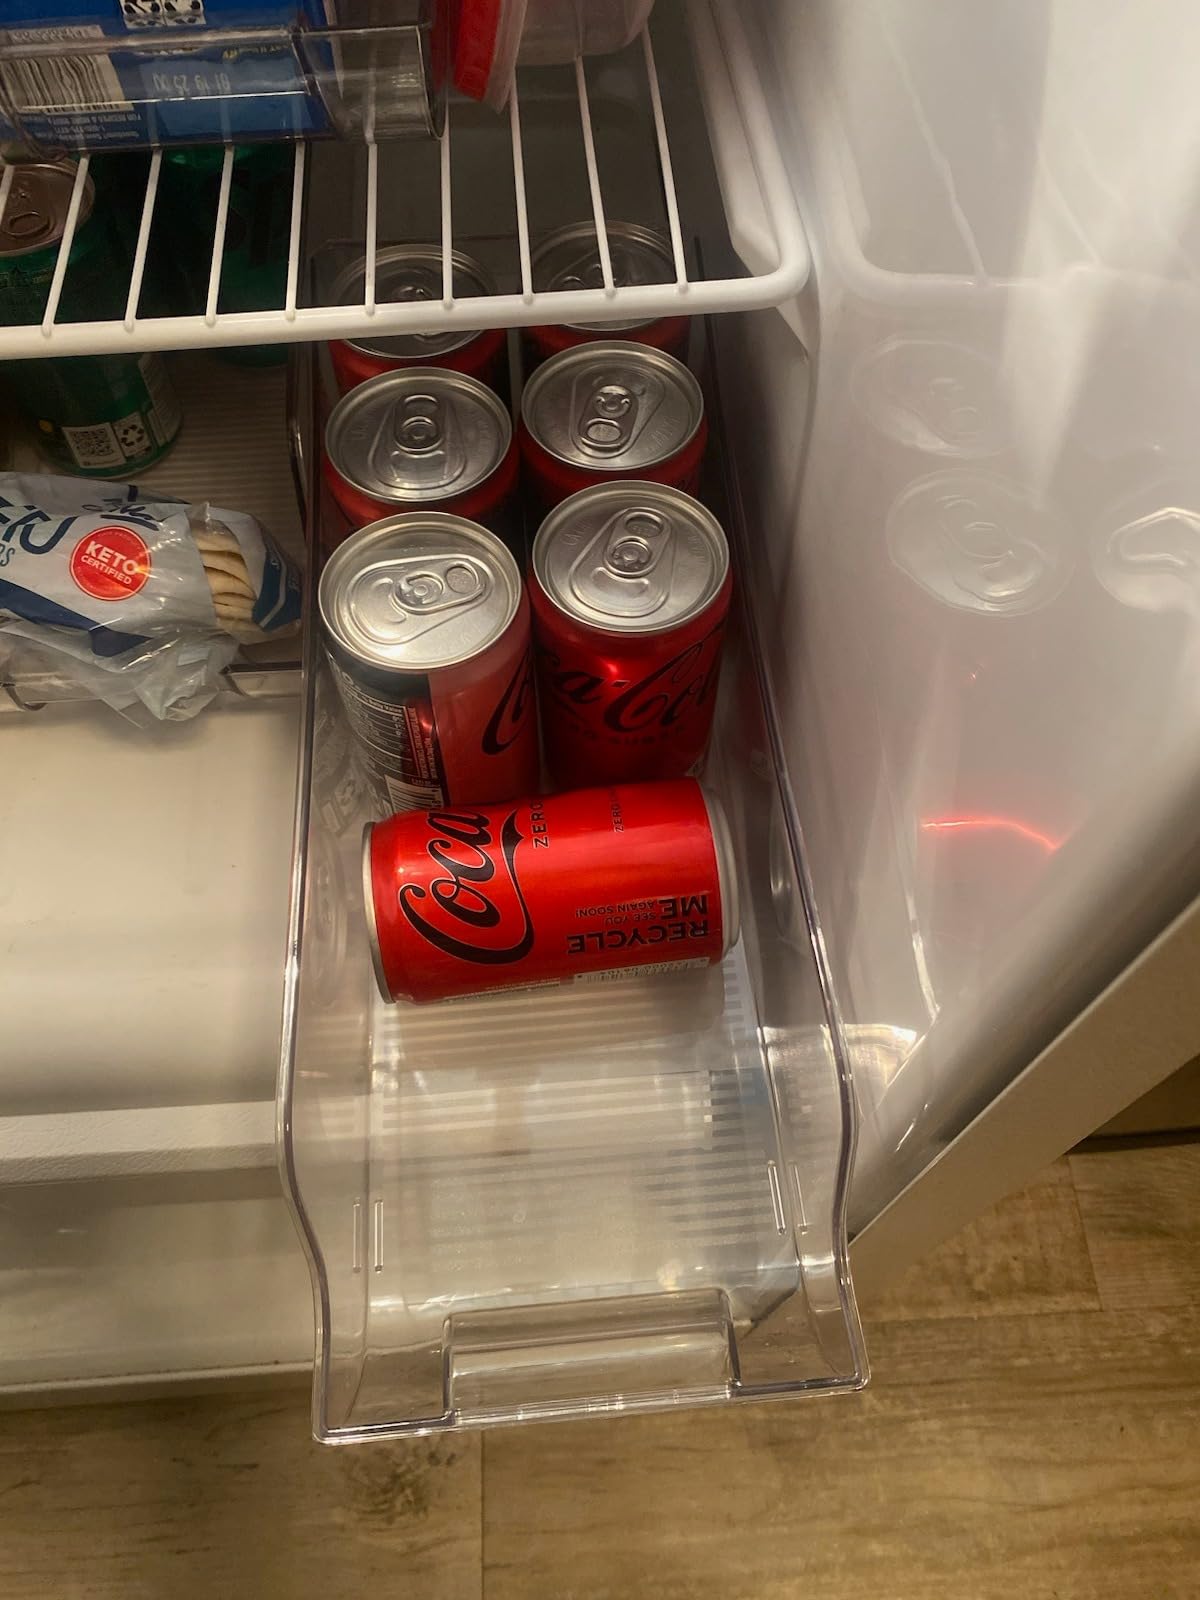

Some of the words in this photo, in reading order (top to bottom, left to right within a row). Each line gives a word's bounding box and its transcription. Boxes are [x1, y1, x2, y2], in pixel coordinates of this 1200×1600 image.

[85, 540, 139, 576] KETO
[81, 555, 132, 585] CERTIFIED
[575, 905, 614, 919] SOON!
[617, 900, 654, 913] AGAIN
[658, 895, 708, 920] ME
[605, 913, 628, 926] YOU
[632, 911, 656, 923] SEE
[567, 919, 709, 955] RECYCLE
